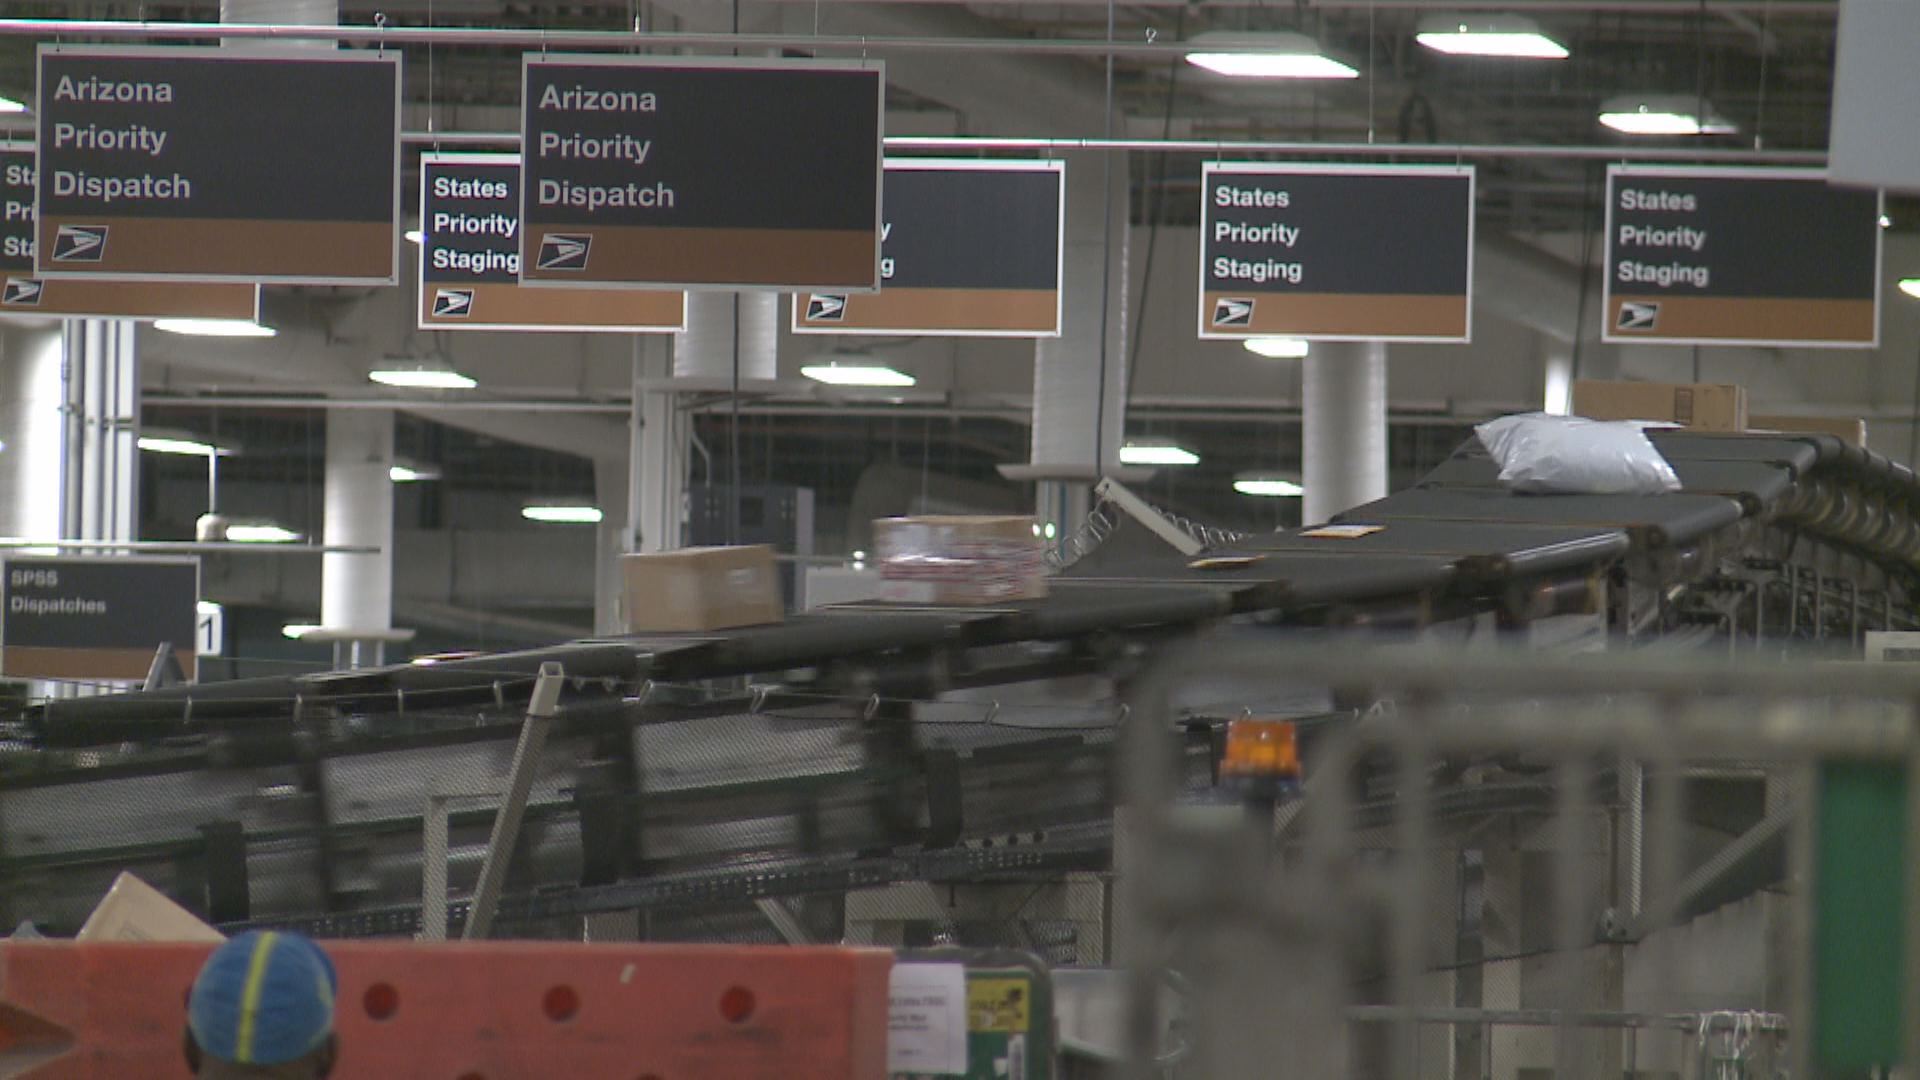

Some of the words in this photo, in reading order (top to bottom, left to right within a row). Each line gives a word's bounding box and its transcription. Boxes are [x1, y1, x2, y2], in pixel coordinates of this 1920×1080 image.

[54, 75, 172, 103] Arizona
[539, 84, 657, 112] Arizona
[55, 123, 167, 156] Priority
[539, 131, 651, 165] Priority
[54, 171, 191, 204] Dispatch
[434, 177, 508, 198] States
[538, 179, 674, 212] Dispatch
[1215, 185, 1290, 208] States
[1620, 188, 1696, 211] States
[5, 201, 34, 221] Pri
[434, 213, 518, 238] Priority
[1214, 221, 1300, 247] Priority
[1619, 224, 1706, 251] Priority
[432, 248, 519, 274] Staging
[1213, 257, 1303, 284] Staging
[1617, 260, 1709, 288] Staging
[11, 569, 58, 588] SPSS
[11, 596, 107, 616] Dispatches
